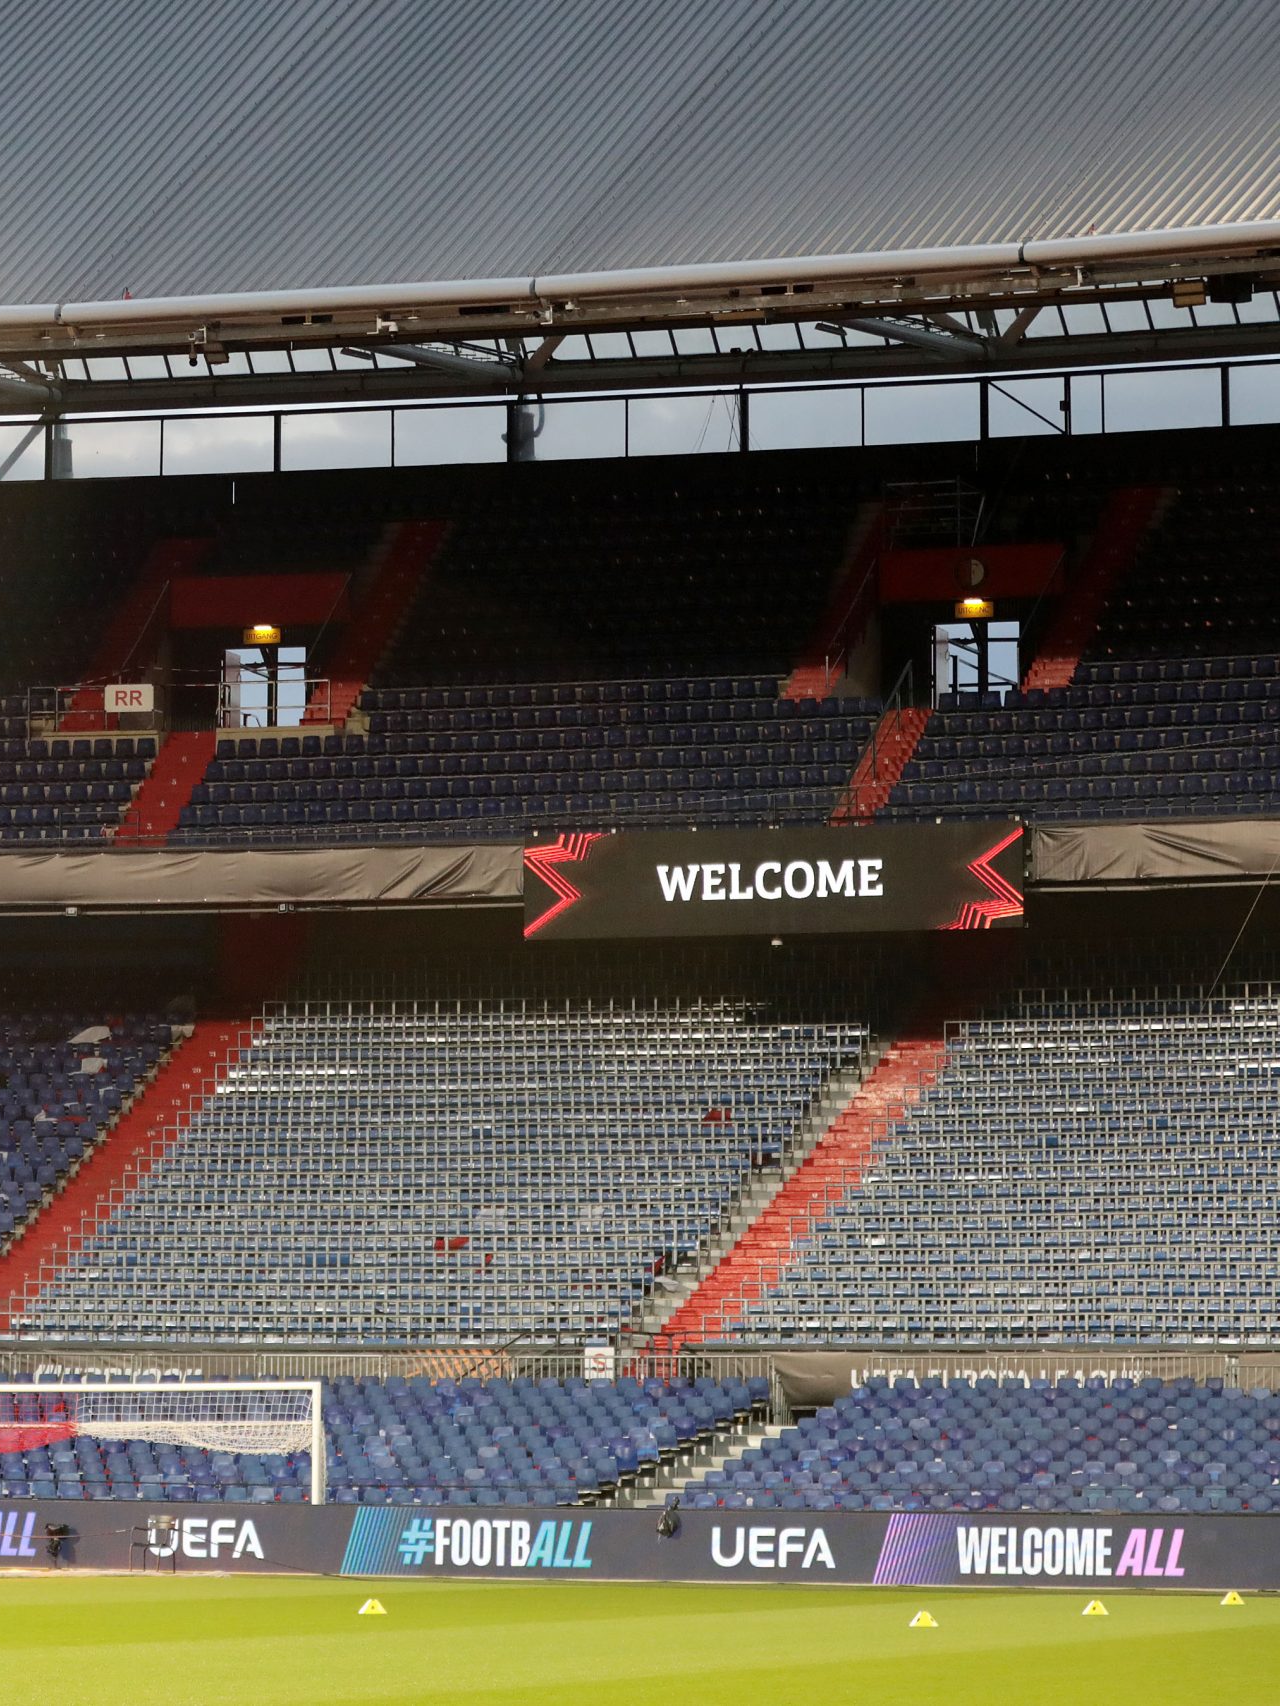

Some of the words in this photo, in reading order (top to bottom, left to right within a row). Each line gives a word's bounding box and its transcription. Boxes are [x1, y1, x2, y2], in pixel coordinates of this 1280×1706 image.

[115, 690, 143, 706] RR
[656, 858, 884, 902] WELCOME
[147, 1518, 265, 1559] UEFA
[398, 1518, 593, 1568] #FOOTBALL
[711, 1526, 836, 1569] UEFA
[956, 1526, 1113, 1577] WELCOME
[1115, 1528, 1186, 1577] ALL
